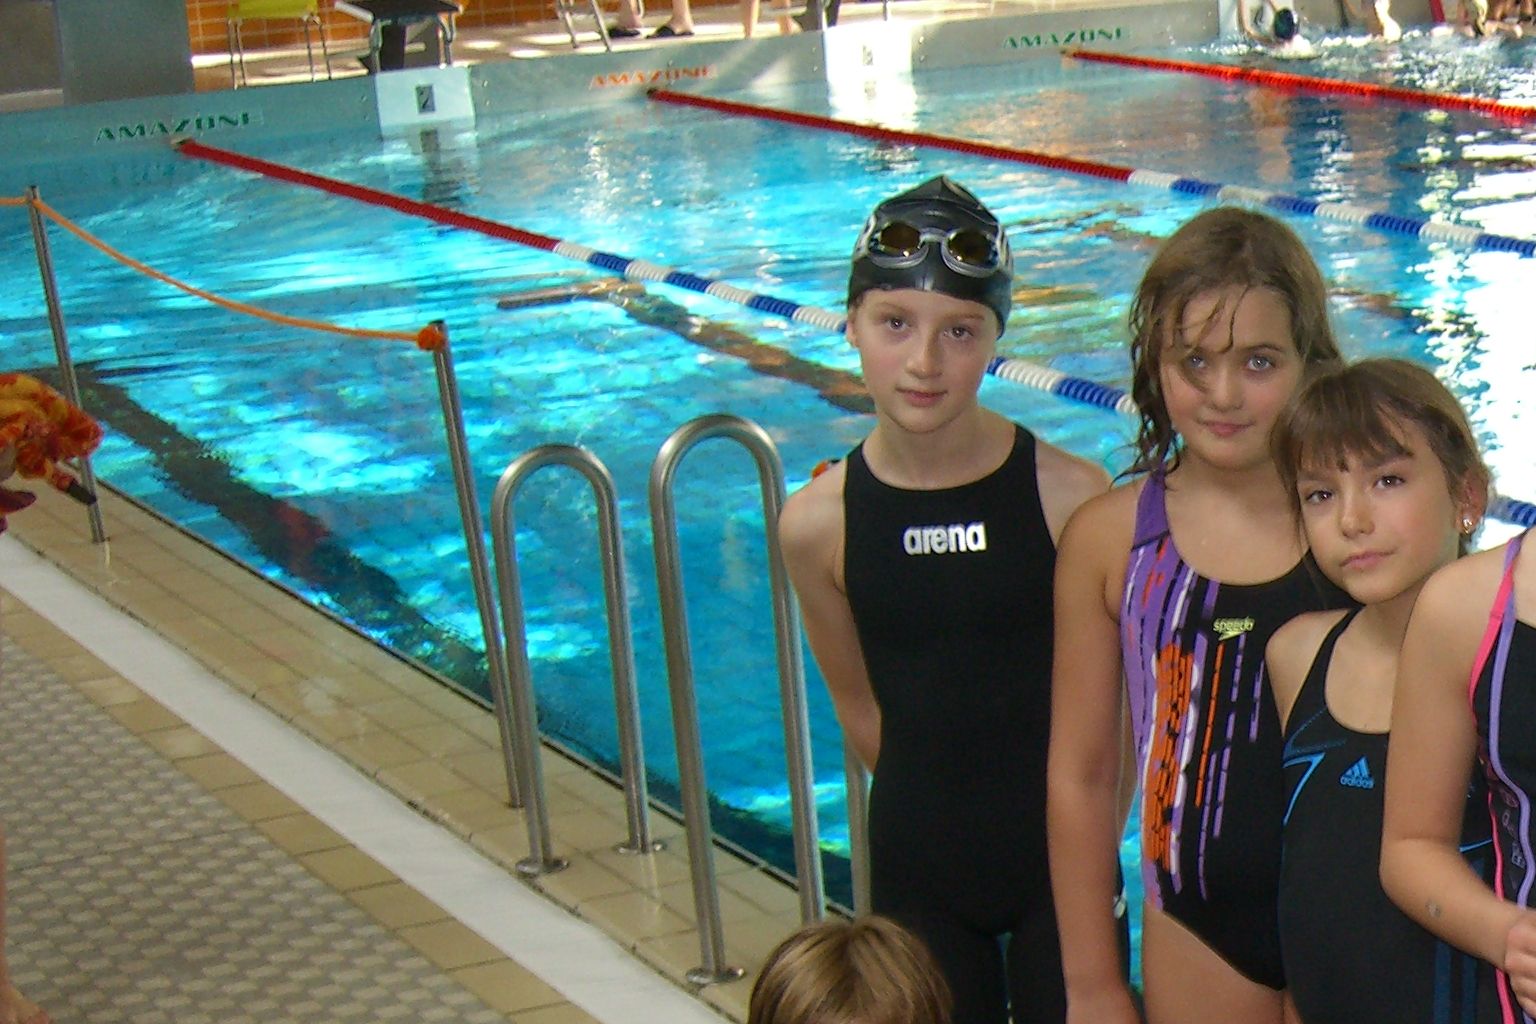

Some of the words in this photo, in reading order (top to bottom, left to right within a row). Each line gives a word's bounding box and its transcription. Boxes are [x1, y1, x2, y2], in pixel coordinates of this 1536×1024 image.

[903, 522, 987, 556] arena
[1213, 616, 1255, 634] speedo
[1340, 774, 1374, 789] adidas
